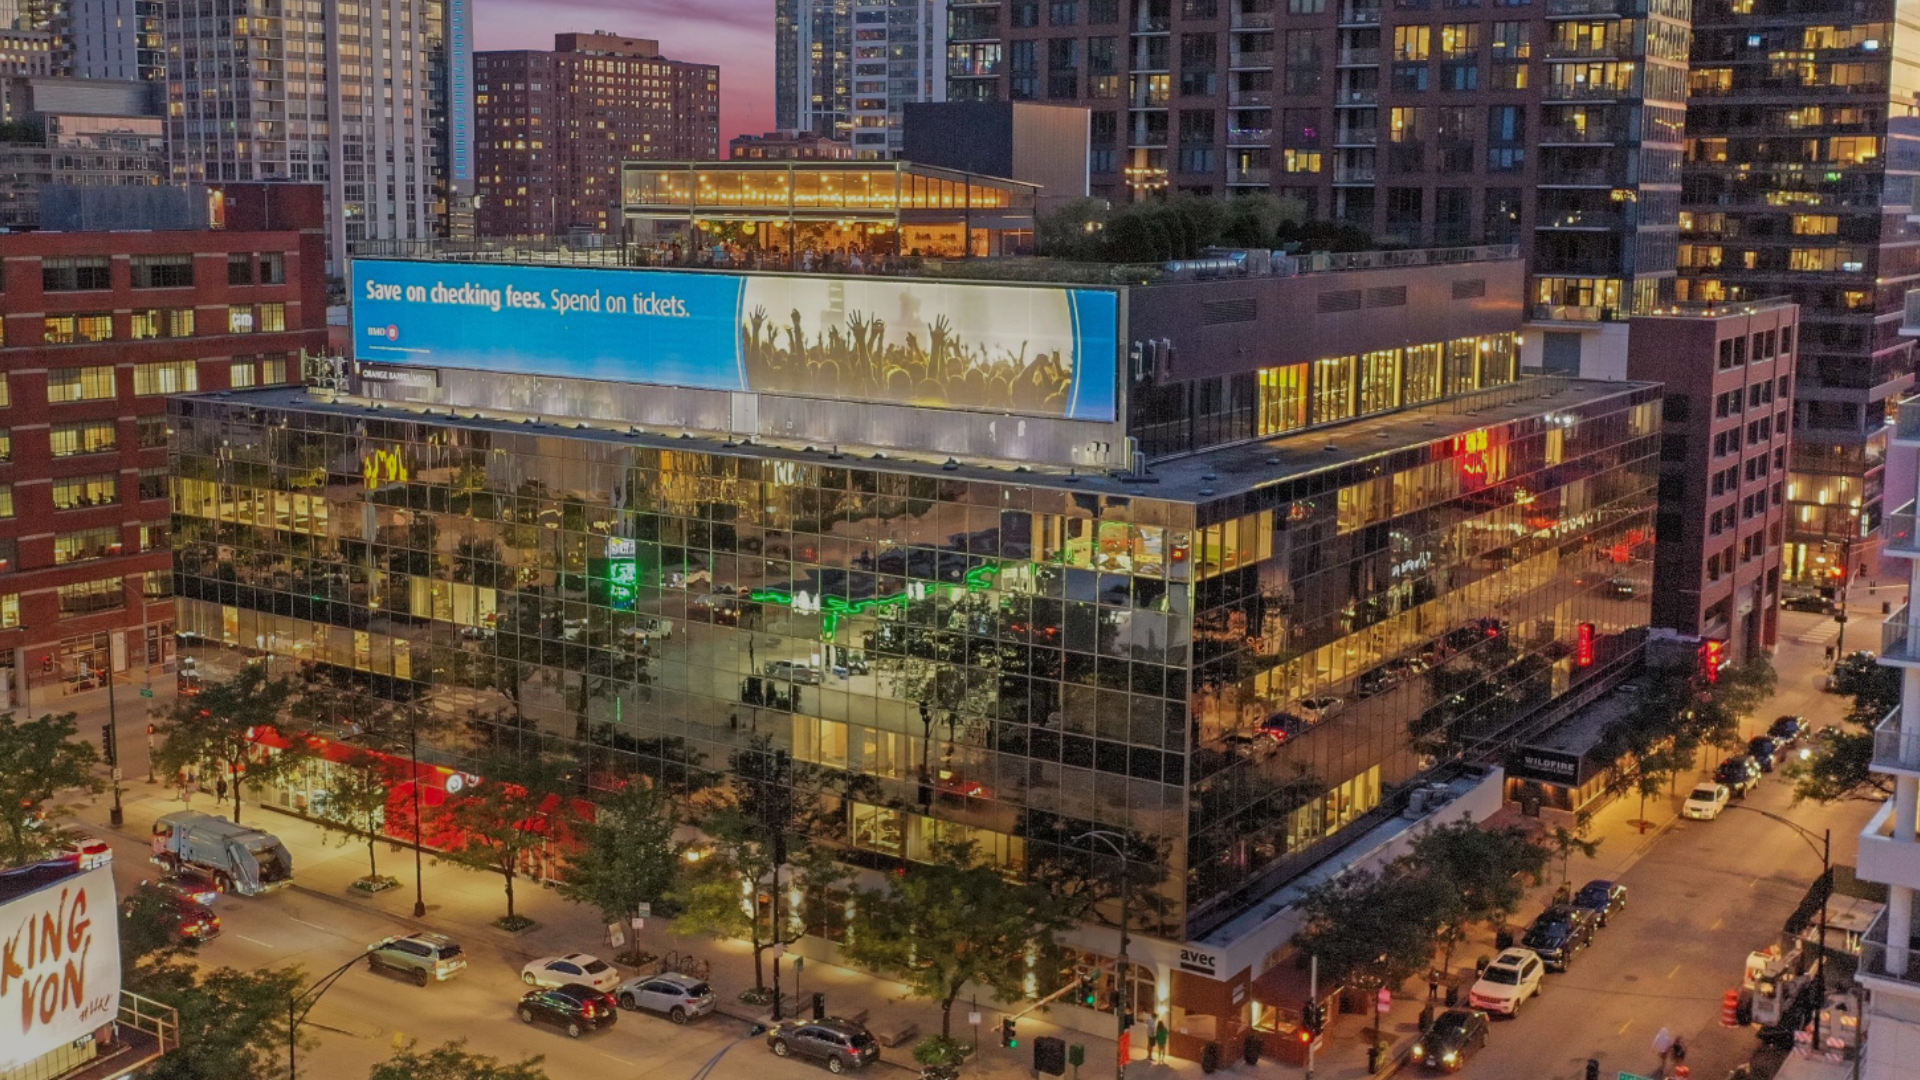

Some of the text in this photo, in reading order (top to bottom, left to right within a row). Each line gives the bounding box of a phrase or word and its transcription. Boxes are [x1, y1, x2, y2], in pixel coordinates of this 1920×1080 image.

[366, 279, 690, 317] Save on checking fees. Spend on tickets.
[367, 326, 386, 337] BMO
[362, 369, 432, 383] ORANGE BARREL MEDIA
[1524, 756, 1575, 771] WILDFIRE
[1, 886, 91, 998] KING
[1180, 949, 1216, 967] avec
[20, 933, 92, 1036] VON
